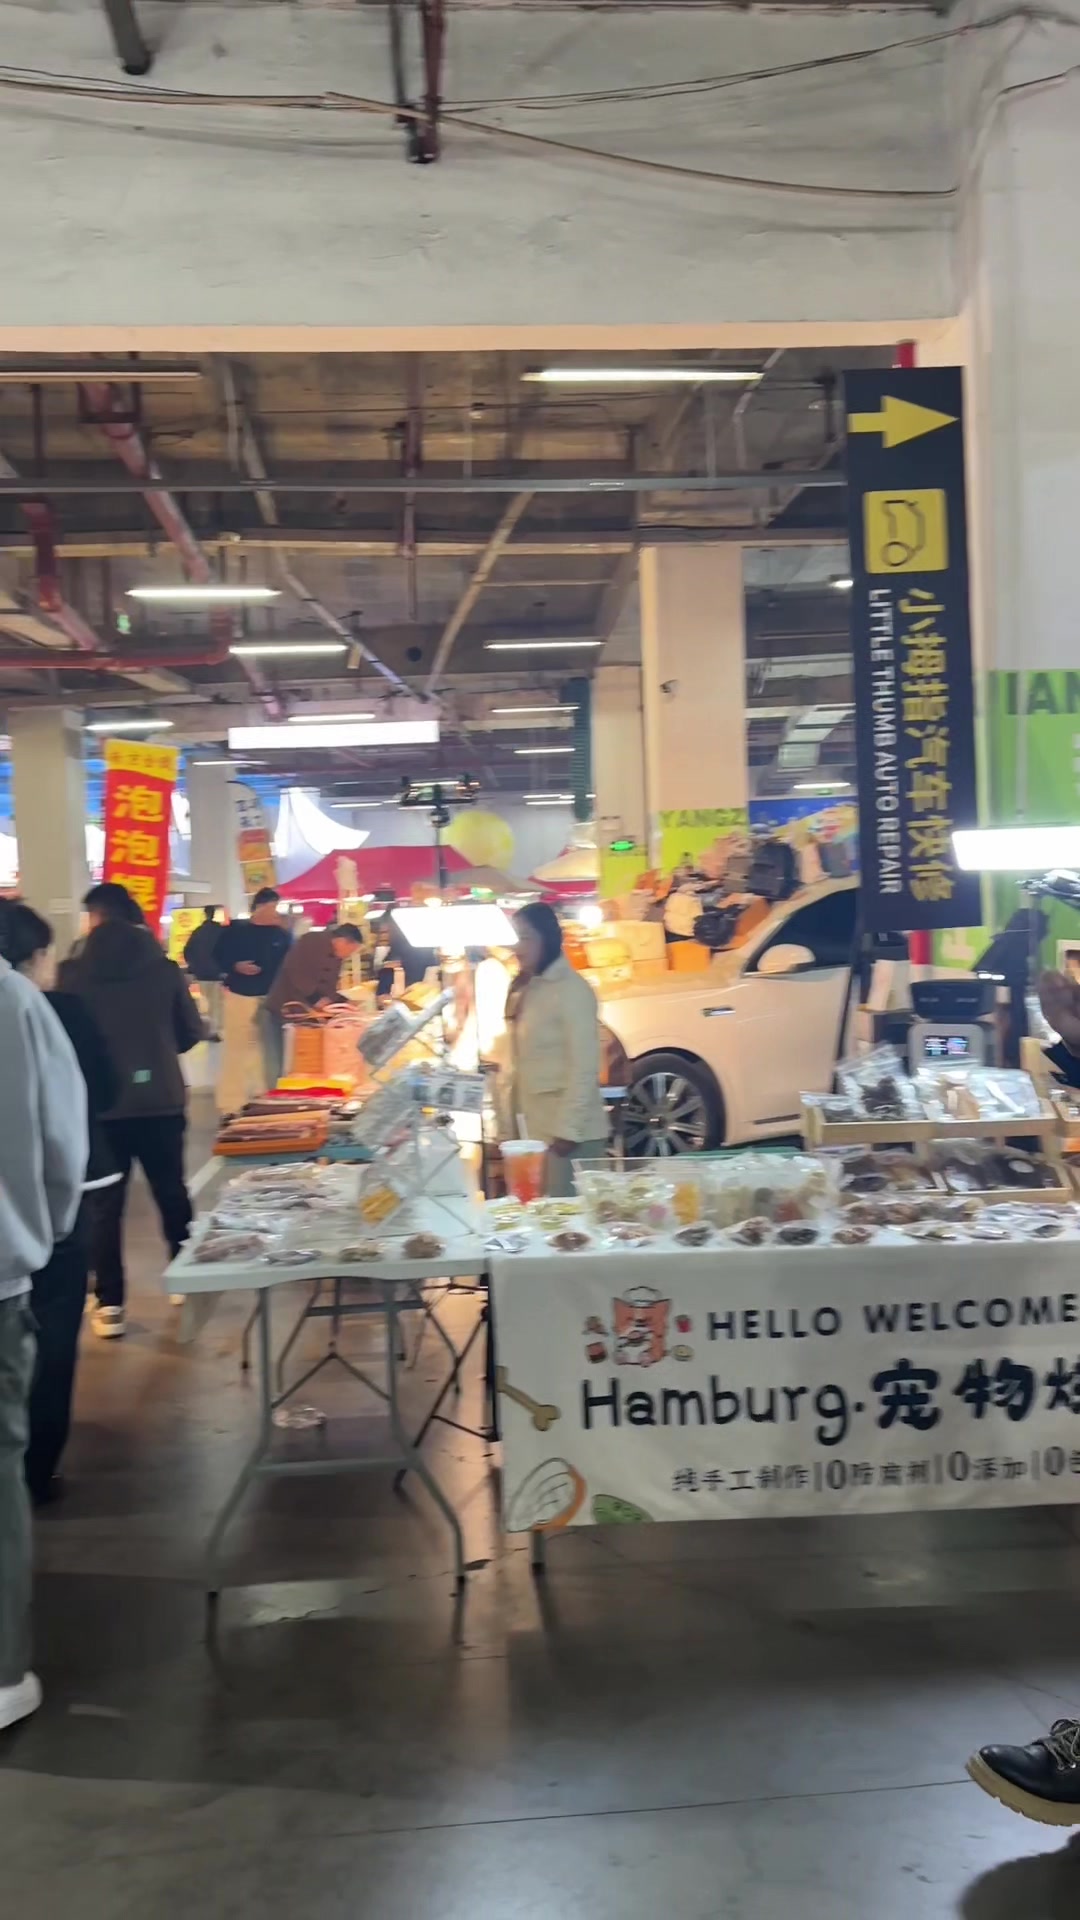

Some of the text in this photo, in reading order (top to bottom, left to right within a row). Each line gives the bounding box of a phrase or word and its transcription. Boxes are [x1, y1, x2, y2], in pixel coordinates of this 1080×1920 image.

[869, 588, 902, 894] LITTLE THUMB AUTO REPAIR
[898, 588, 956, 901] 小拇指汽车快修
[707, 1293, 1078, 1341] HELLO WELCOME
